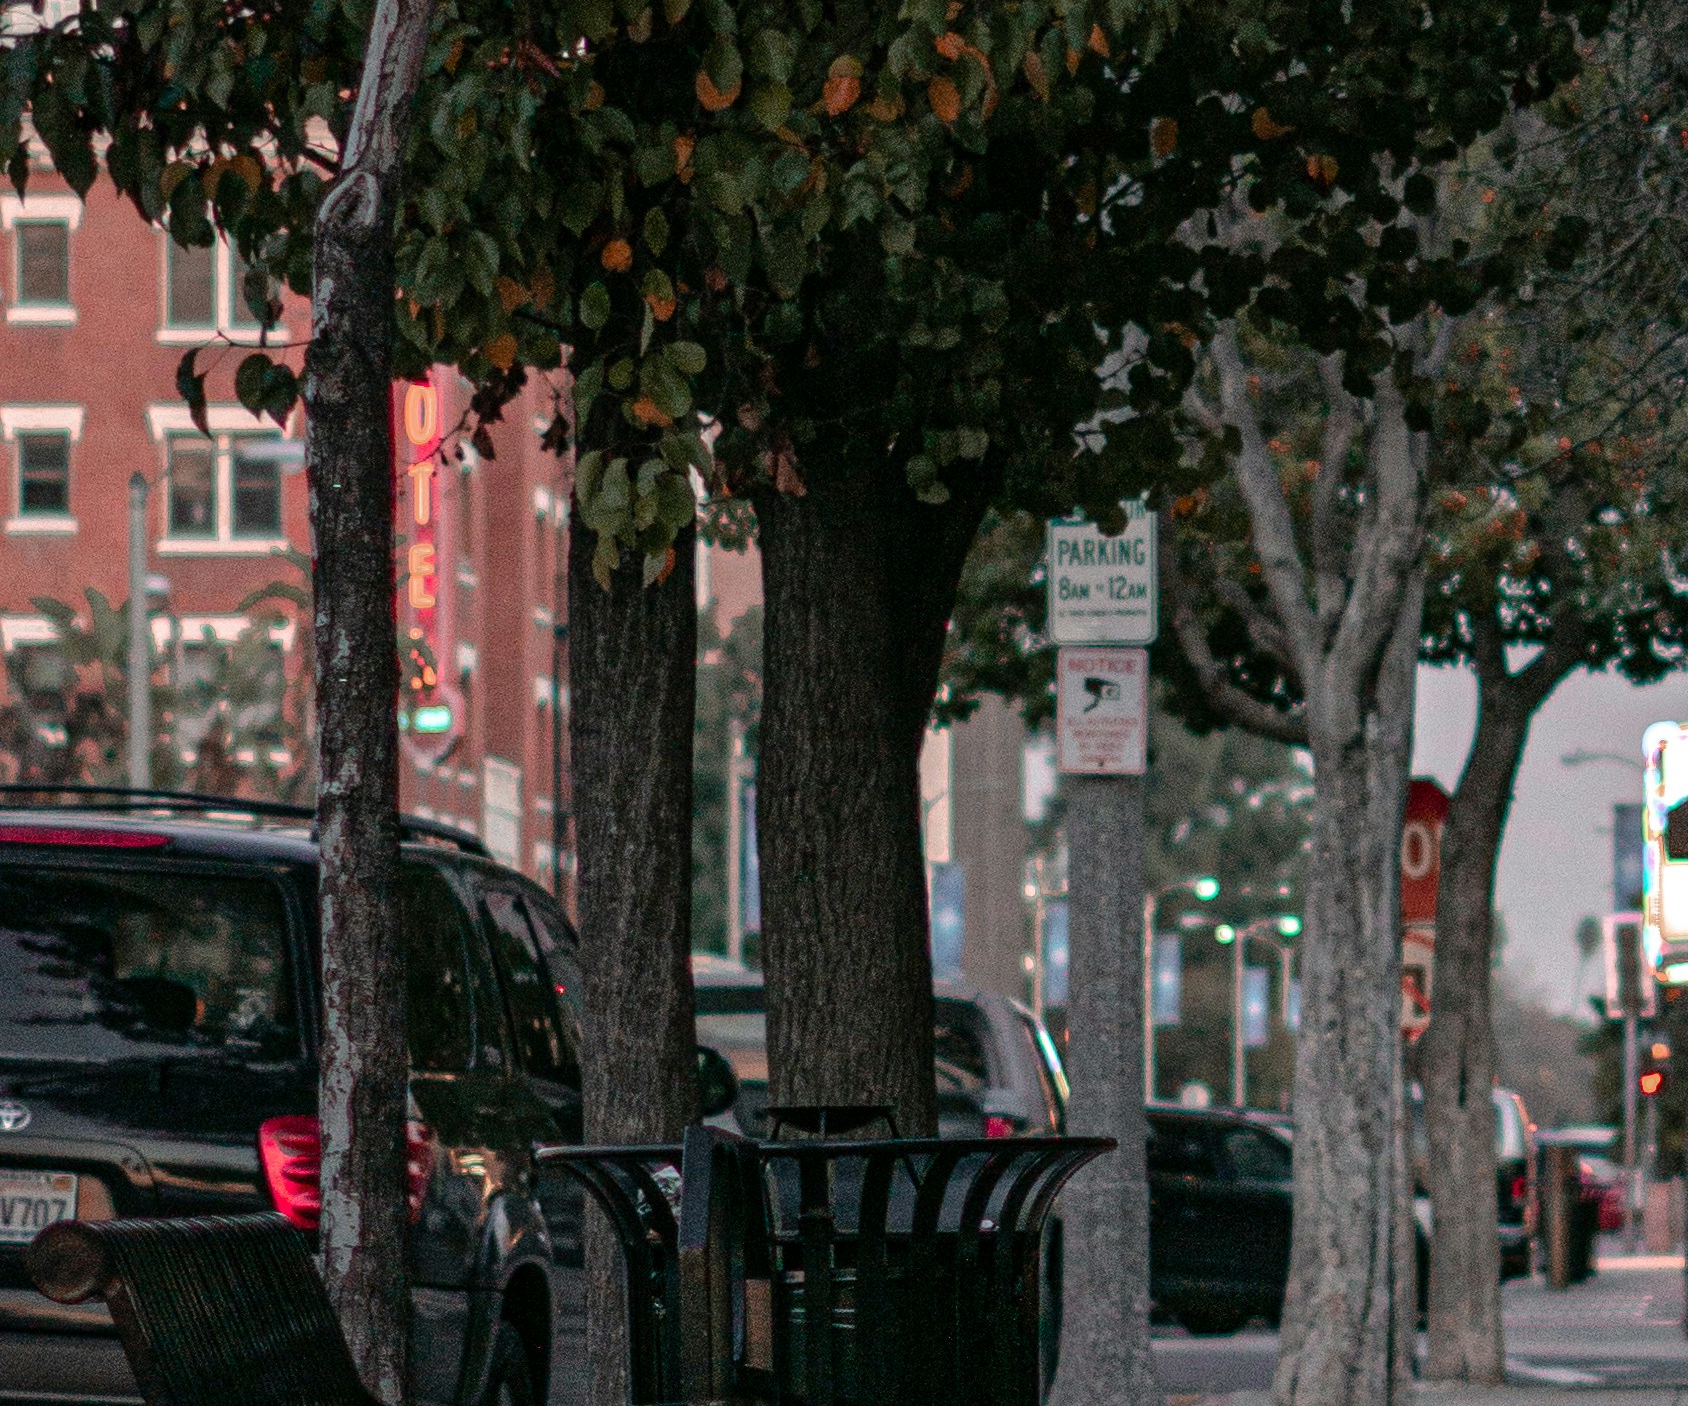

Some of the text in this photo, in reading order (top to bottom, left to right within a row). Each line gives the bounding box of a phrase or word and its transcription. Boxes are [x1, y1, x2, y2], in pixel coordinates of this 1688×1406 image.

[403, 381, 437, 610] OTEL
[1057, 538, 1146, 566] PARKING
[1058, 576, 1090, 601] 8AM
[1108, 575, 1148, 601] 12AM
